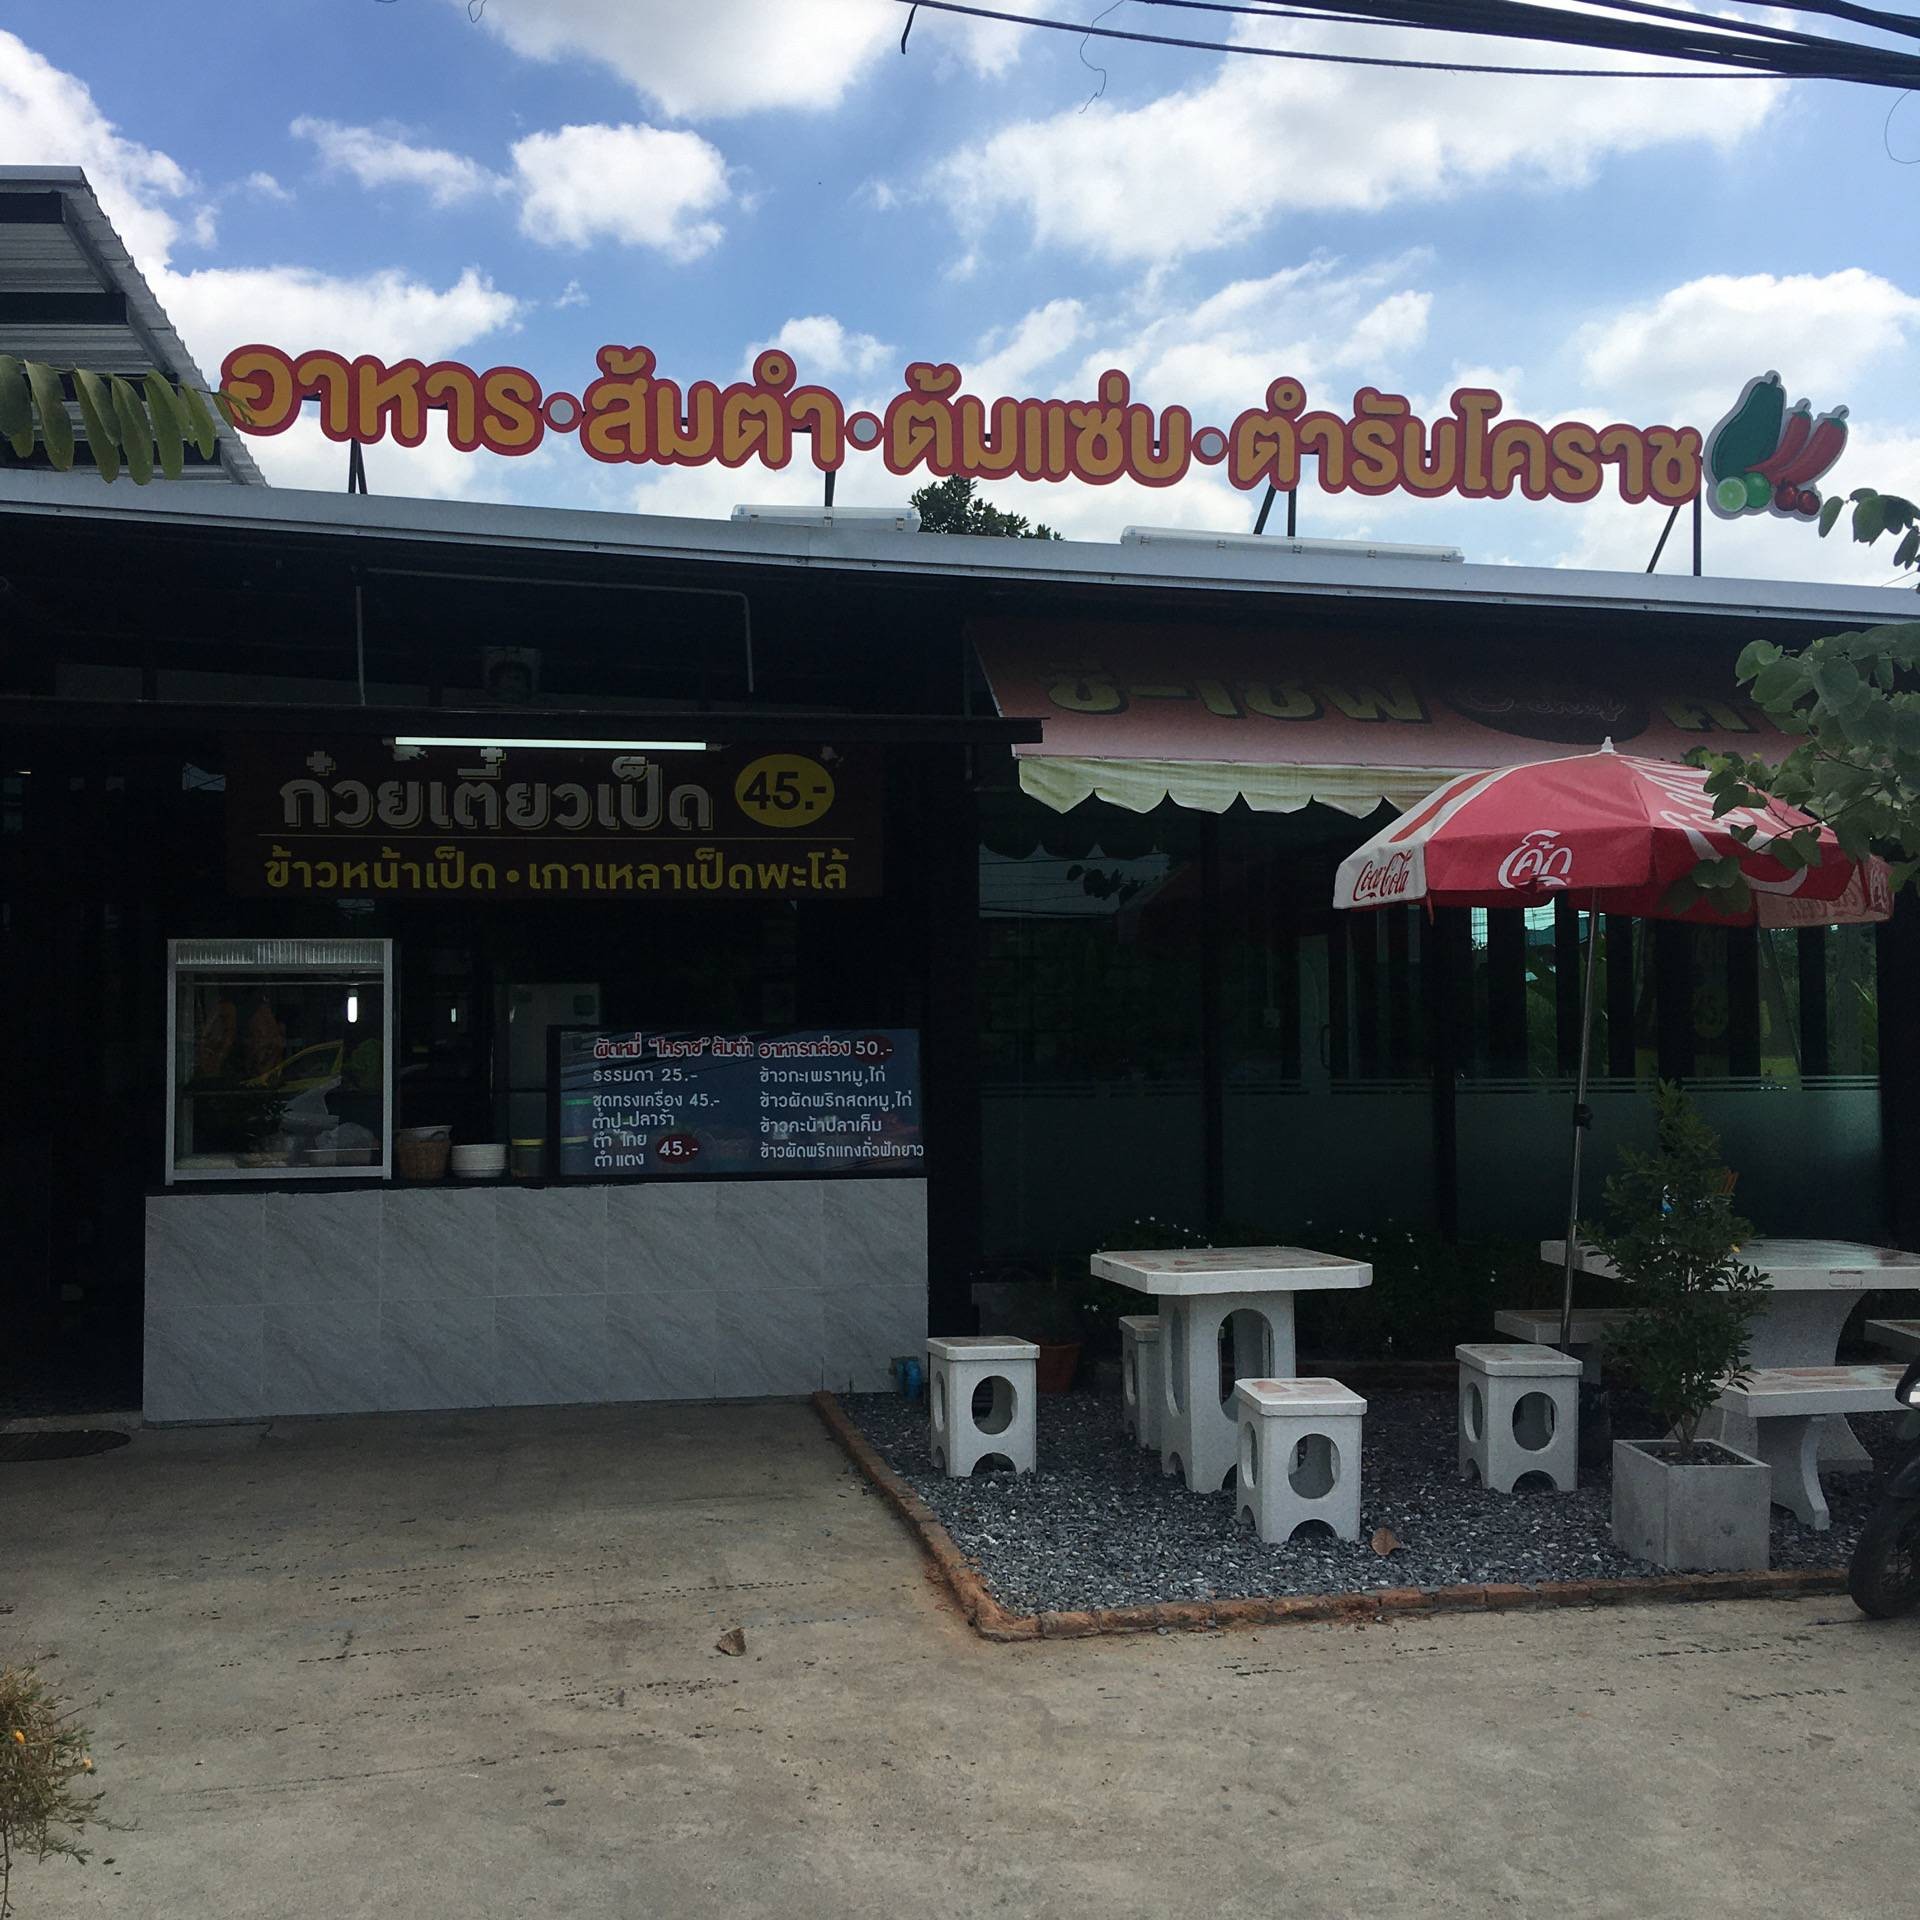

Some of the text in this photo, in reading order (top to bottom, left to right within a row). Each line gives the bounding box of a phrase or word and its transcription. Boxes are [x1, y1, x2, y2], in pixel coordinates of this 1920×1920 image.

[221, 344, 1703, 506] อาหาร ส้มตำ ต้มแซ่บ ตำรับโคราช
[279, 746, 714, 831] ก๋วยเตี๋ยวเป็ด
[742, 769, 828, 811] 45.-
[263, 844, 850, 890] ข้าวหน้าเป็ด เกาเหลาเป็ดพะโล้
[758, 1035, 895, 1059] อาหารกล่อง 50.-
[592, 1068, 698, 1083] ธรรมดา 25.-
[592, 1089, 721, 1111] ชุดทรงเครื่อง 45.-
[658, 1141, 699, 1156] 45.-
